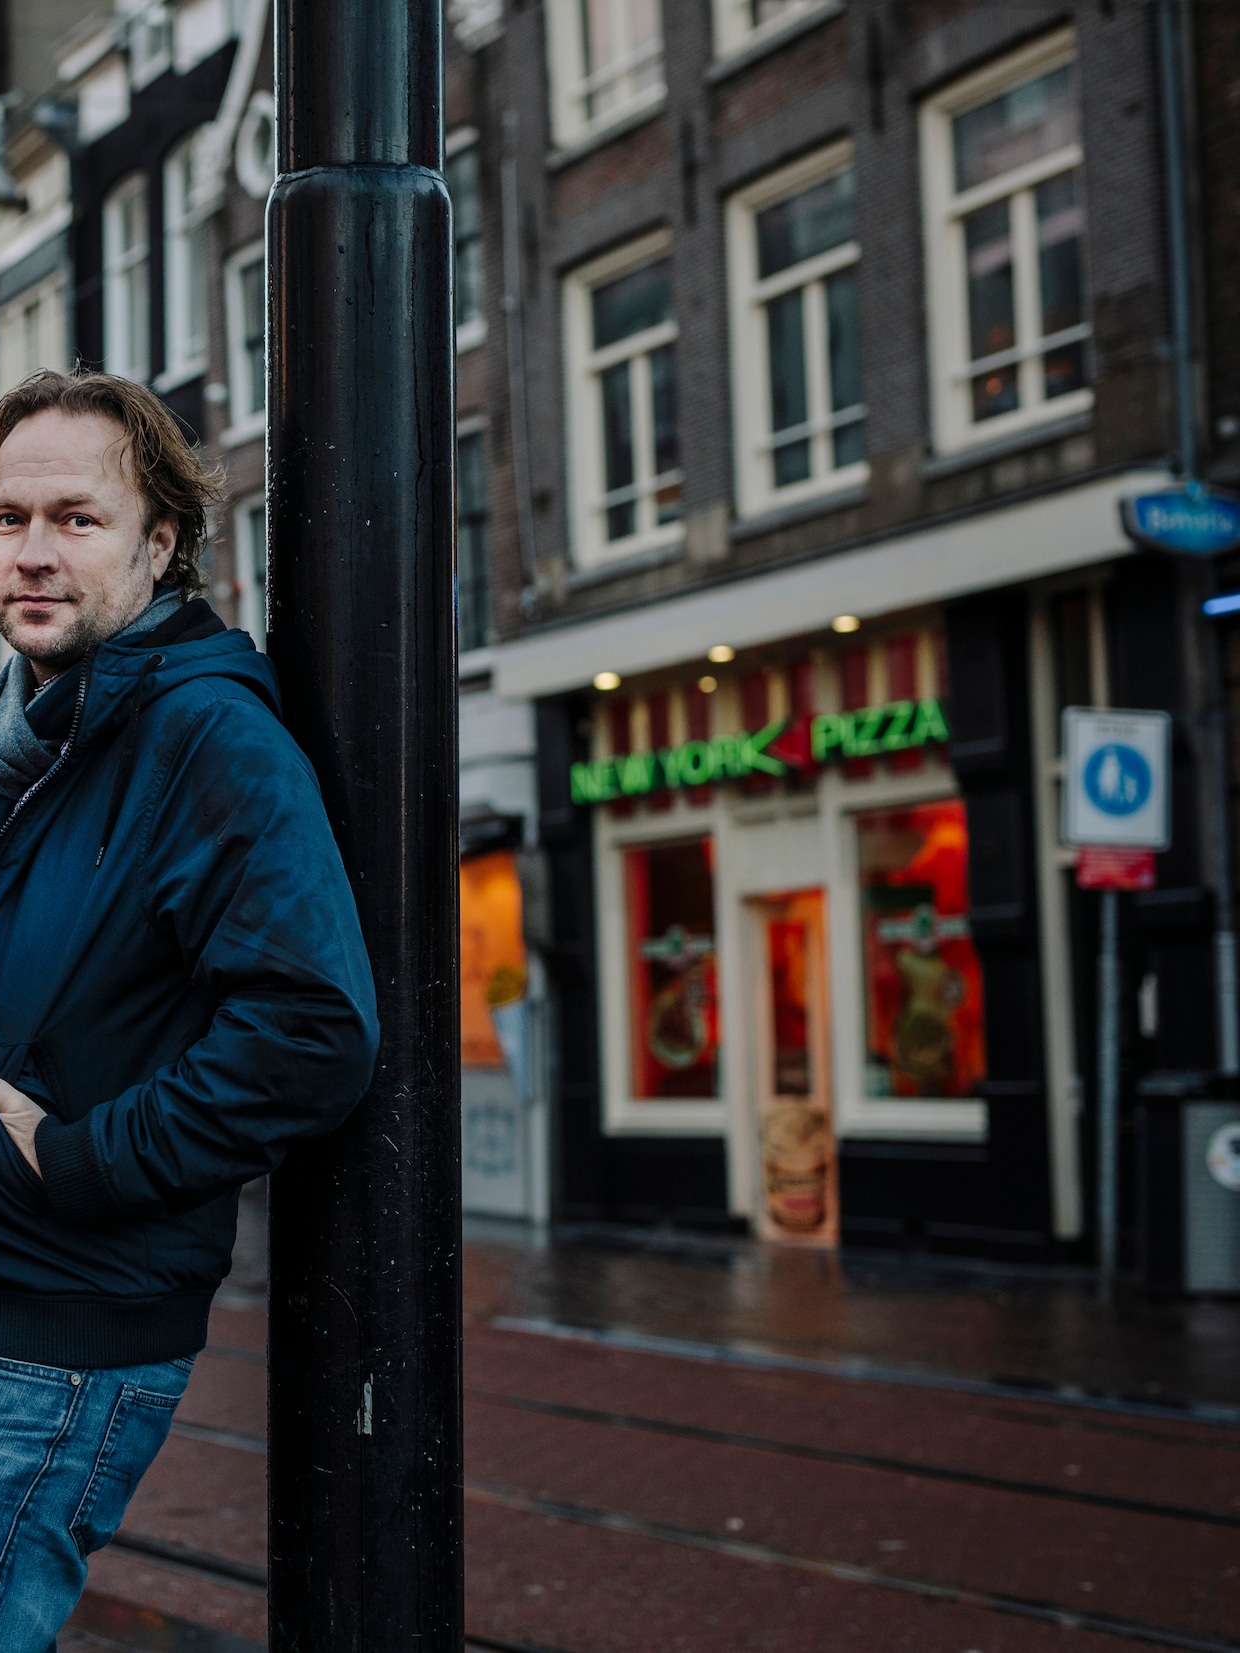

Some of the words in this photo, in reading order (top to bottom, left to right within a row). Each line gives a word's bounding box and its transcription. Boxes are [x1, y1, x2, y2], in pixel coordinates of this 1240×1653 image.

[570, 754, 658, 804] NEW
[660, 717, 786, 788] YORK
[811, 700, 949, 761] PIZZA
